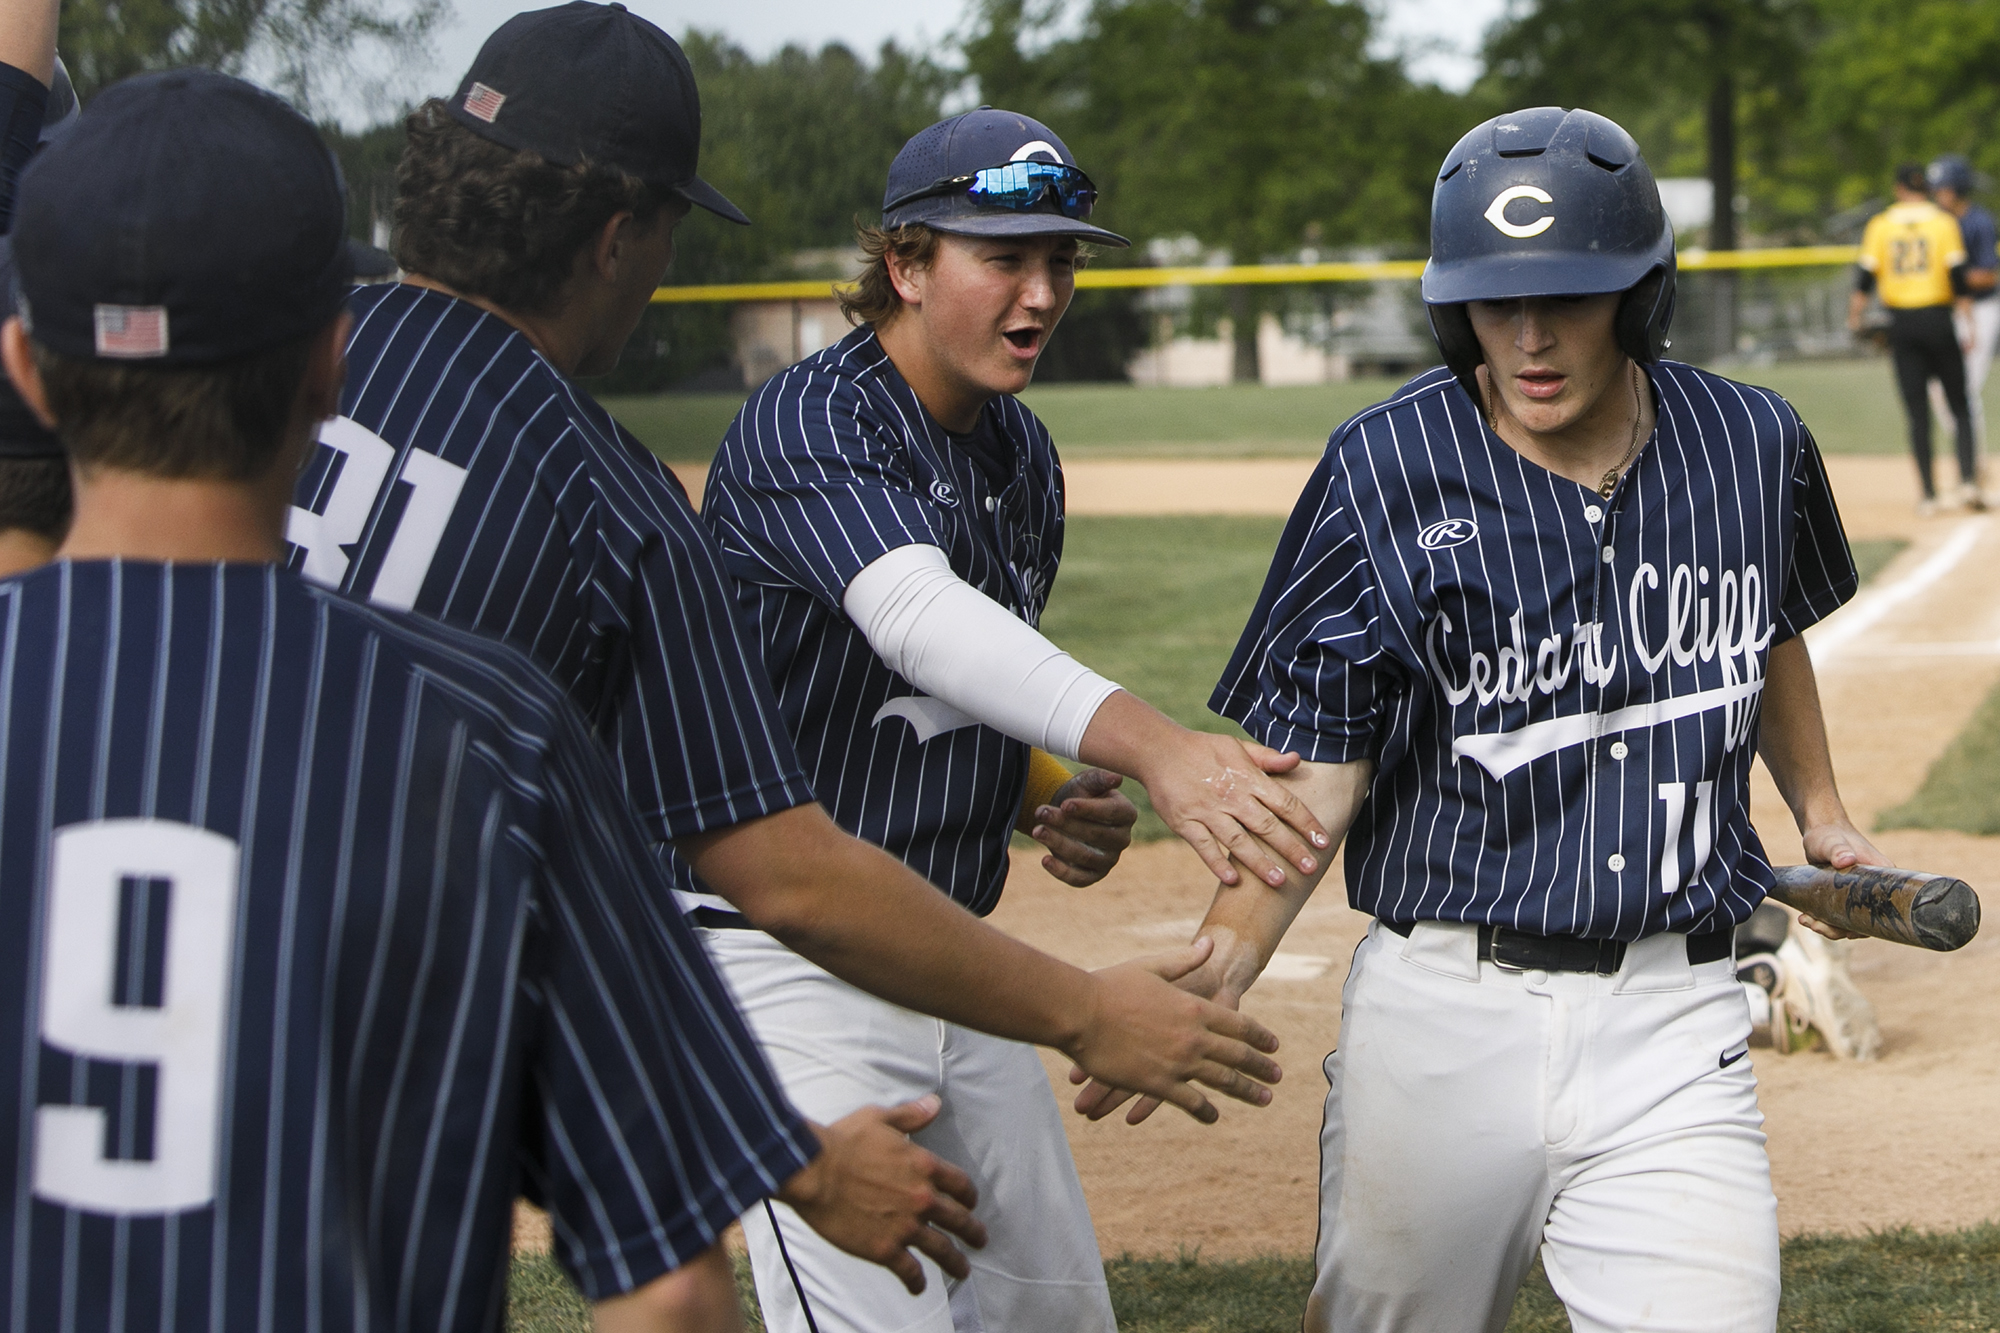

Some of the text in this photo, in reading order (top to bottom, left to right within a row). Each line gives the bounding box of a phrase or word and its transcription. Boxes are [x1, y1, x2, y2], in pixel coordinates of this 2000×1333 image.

[1484, 185, 1555, 238] C
[1426, 562, 1776, 753] Cedar Cliff
[1658, 780, 1713, 893] 11
[32, 817, 240, 1217] 9
